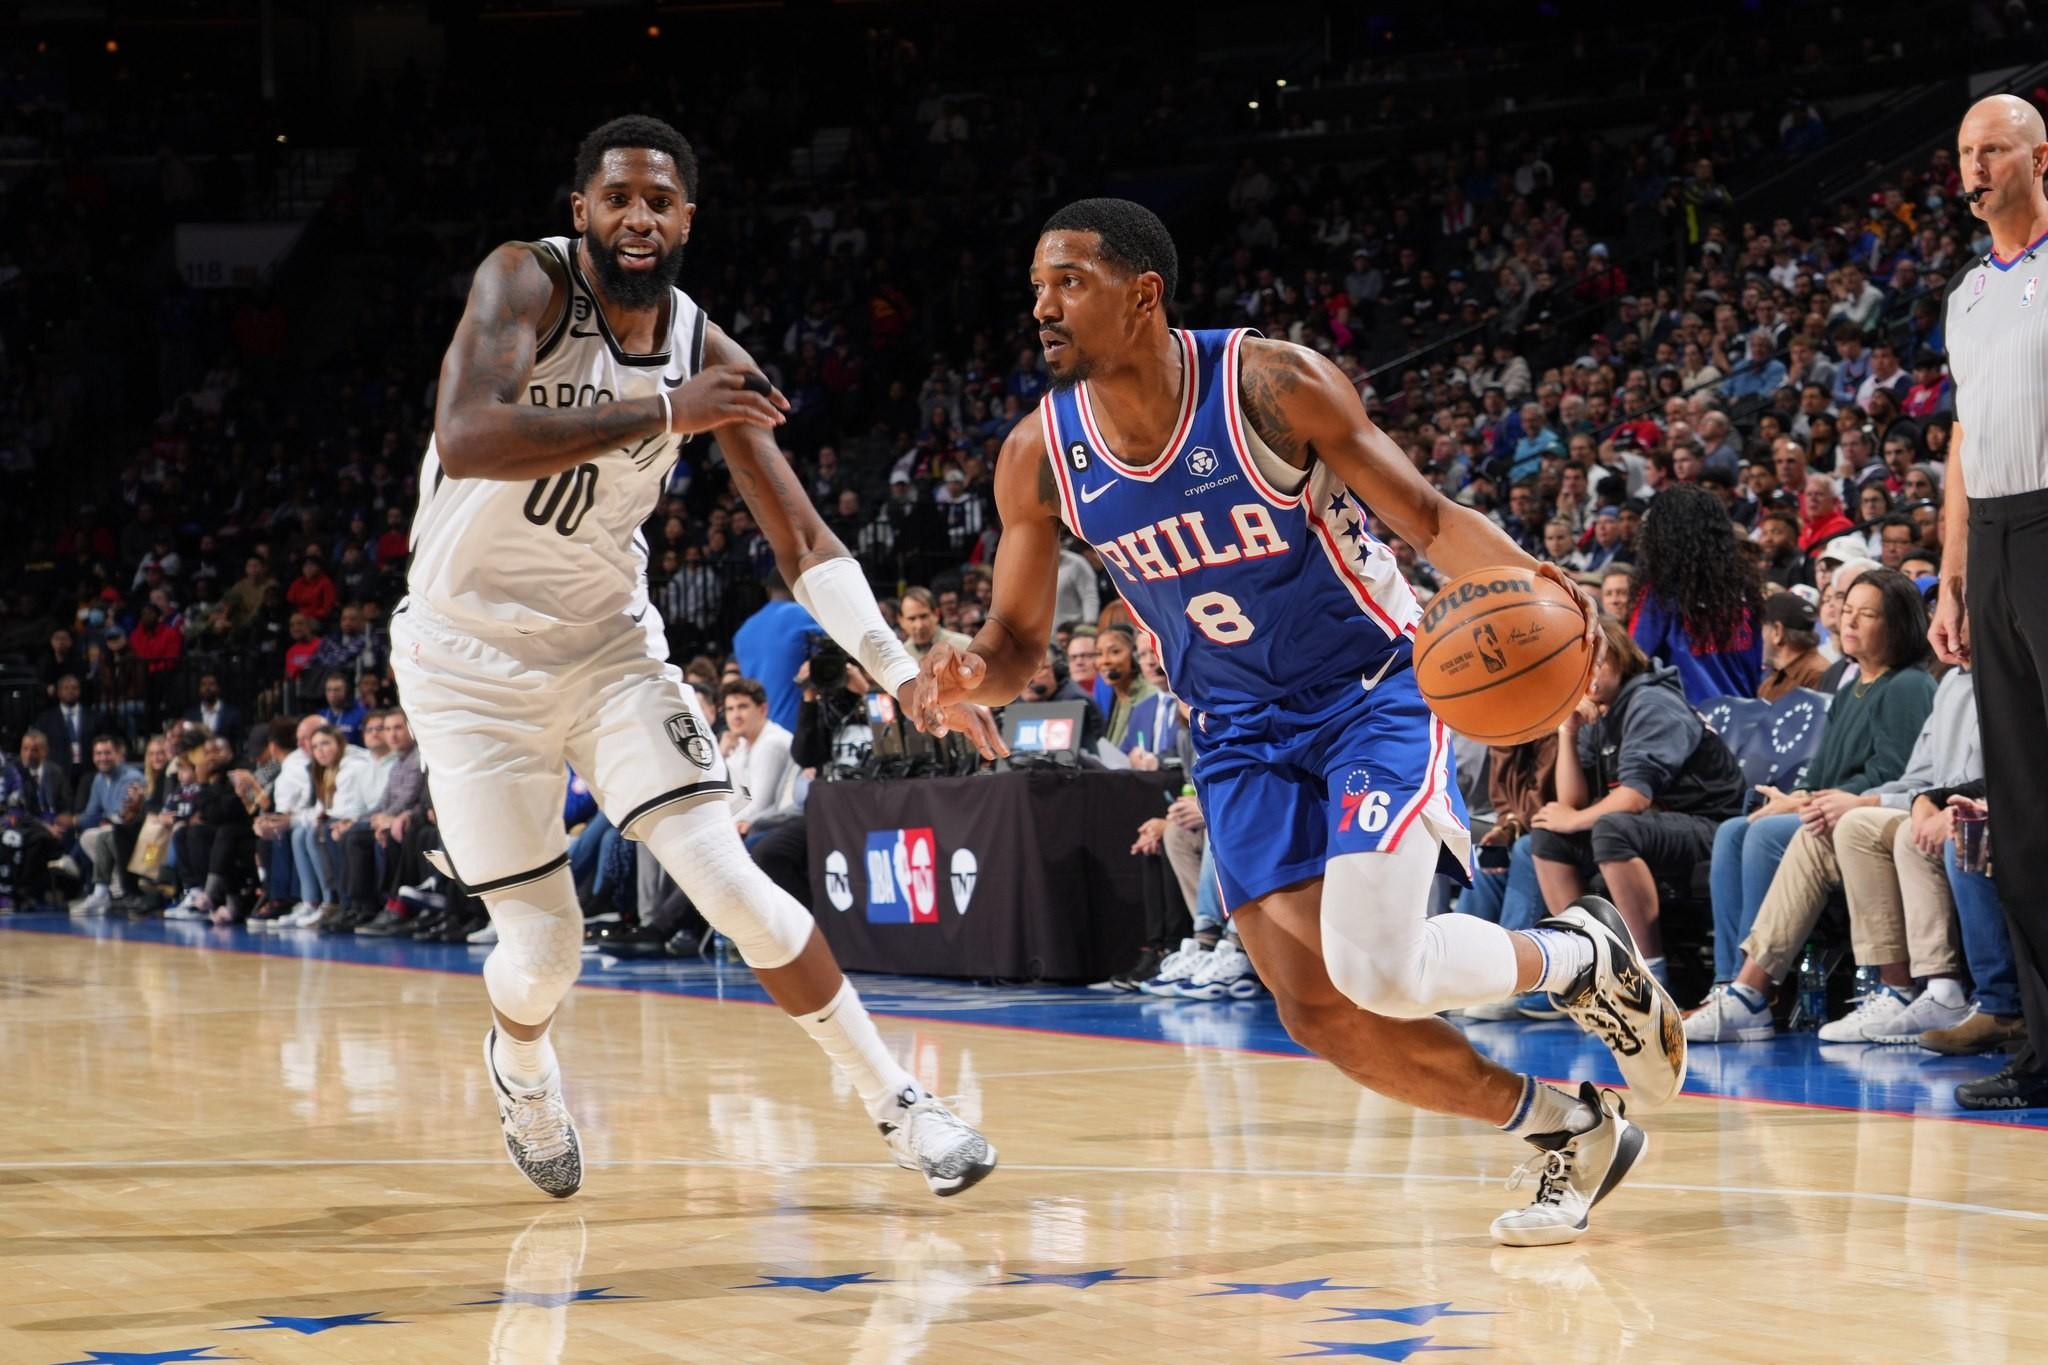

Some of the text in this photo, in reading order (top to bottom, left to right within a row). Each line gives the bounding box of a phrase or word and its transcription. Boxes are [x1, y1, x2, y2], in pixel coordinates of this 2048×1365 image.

[1071, 444, 1088, 469] 6
[523, 462, 598, 536] 00
[1184, 473, 1239, 497] crypto.com
[1094, 503, 1290, 582] PHILA
[1185, 591, 1255, 646] 8
[1422, 578, 1533, 634] Wilson
[1338, 789, 1391, 832] 76
